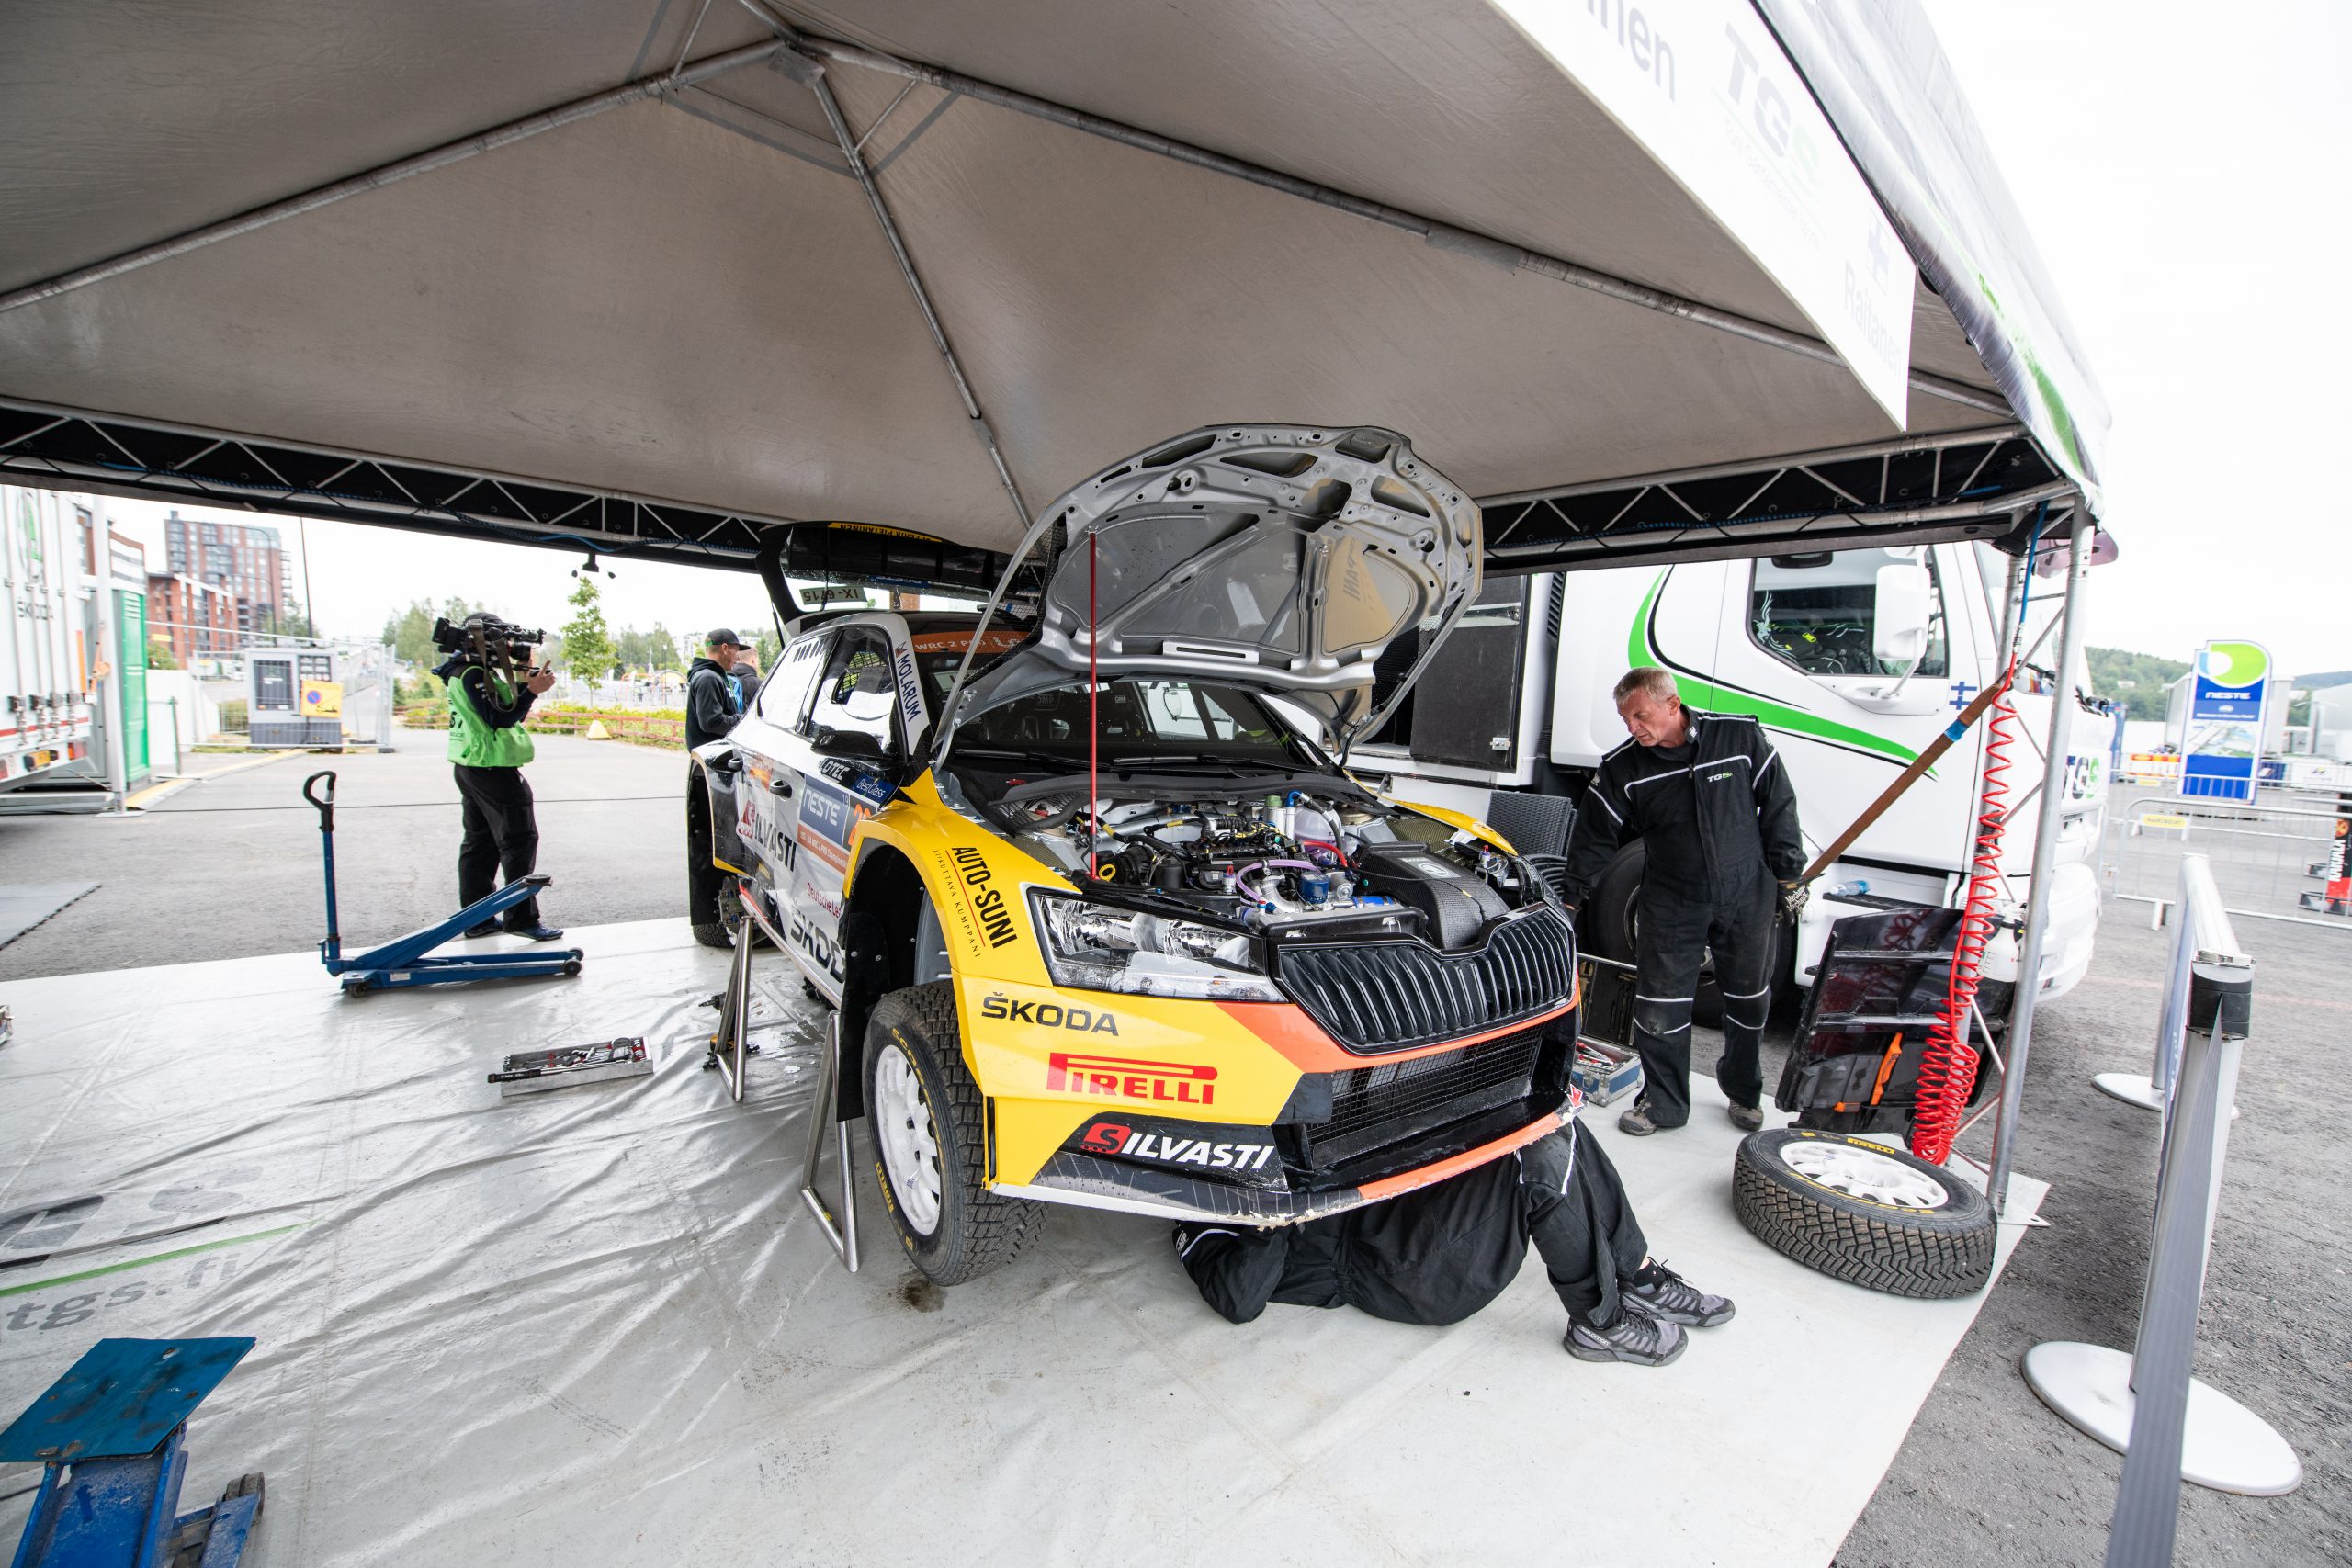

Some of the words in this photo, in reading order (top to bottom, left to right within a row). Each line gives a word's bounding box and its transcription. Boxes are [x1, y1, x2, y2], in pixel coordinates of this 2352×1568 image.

[1724, 21, 1824, 197] TGS
[1843, 259, 1902, 382] Raitanen
[914, 642, 946, 651] WRC
[897, 653, 922, 722] MOLARUM
[2205, 691, 2252, 700] NESTE
[738, 799, 797, 872] SILVASTI
[802, 787, 841, 827] NESTE
[951, 847, 1018, 949] AUTO-SUNI
[955, 901, 981, 957] KUMPPANI
[790, 898, 846, 984] ŠKOD
[981, 991, 1119, 1037] ŠKODA
[1046, 1052, 1218, 1105] PIRELLI
[1080, 1122, 1275, 1169] SILVASTI
[6, 1253, 241, 1331] tgs.fi
